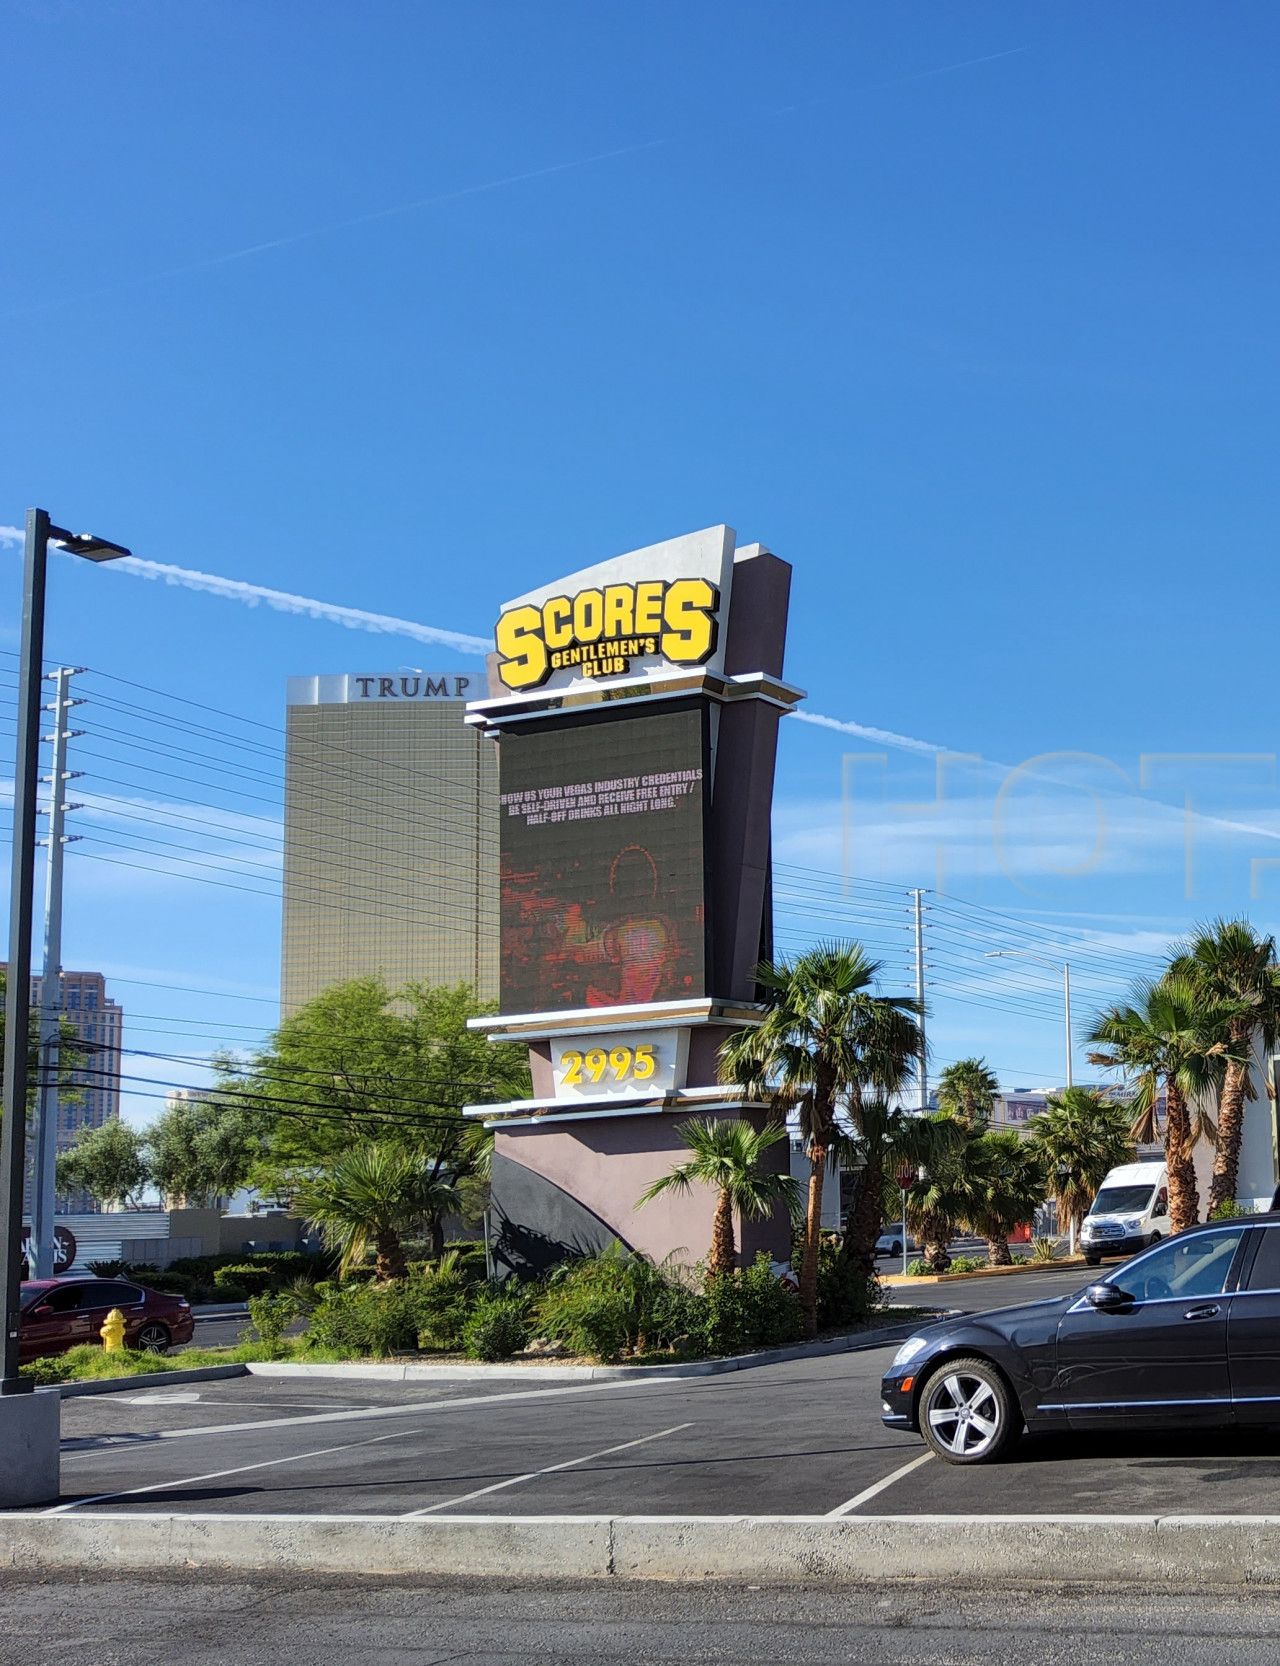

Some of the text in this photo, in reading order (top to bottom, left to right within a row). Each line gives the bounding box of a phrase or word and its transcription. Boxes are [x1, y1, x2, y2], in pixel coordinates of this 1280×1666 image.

[495, 578, 717, 690] SCORES
[551, 637, 655, 669] GENTLEMEN'S
[582, 657, 625, 678] CLUB
[356, 677, 470, 698] TRUMP
[500, 769, 703, 805] HOW US YOUR VEGAS INDUSTRY CREDENTIALS
[578, 795, 597, 807] AND
[598, 790, 635, 804] RECEIVE
[636, 786, 658, 800] FREE
[659, 782, 689, 797] ENTRY
[526, 810, 567, 826] HALF-OFF
[568, 806, 603, 820] DRINKS
[603, 804, 620, 816] ALL
[620, 799, 649, 814] NIGHT
[560, 1044, 656, 1085] 2995
